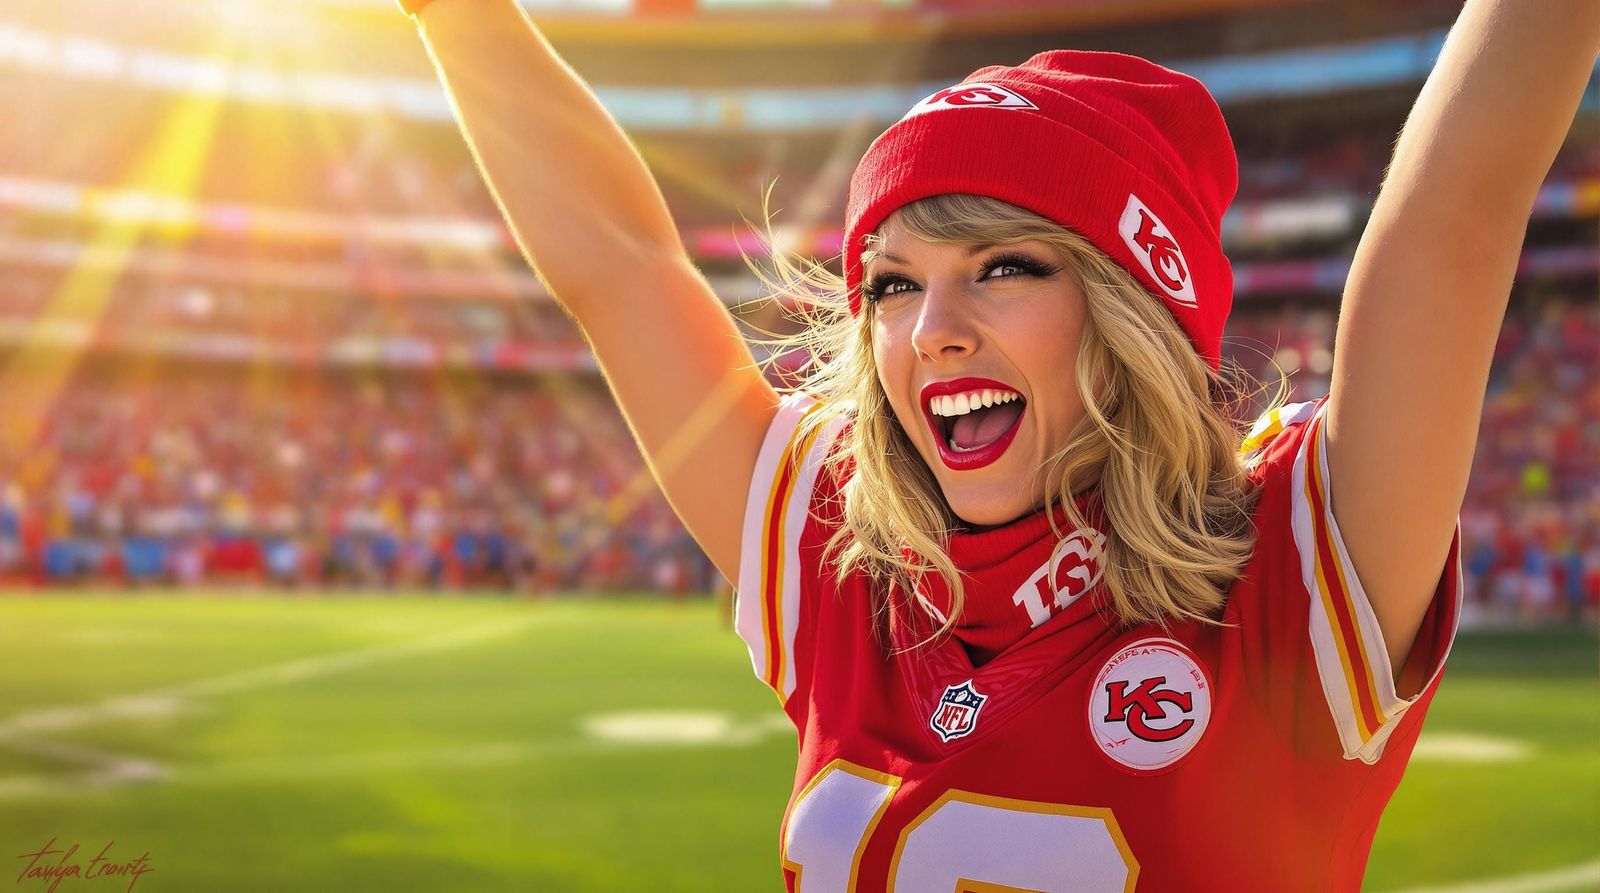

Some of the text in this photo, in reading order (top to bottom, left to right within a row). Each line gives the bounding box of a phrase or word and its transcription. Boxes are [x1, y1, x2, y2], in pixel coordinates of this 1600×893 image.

[1132, 208, 1187, 292] KC
[936, 704, 970, 731] NFL
[1104, 676, 1195, 743] KC
